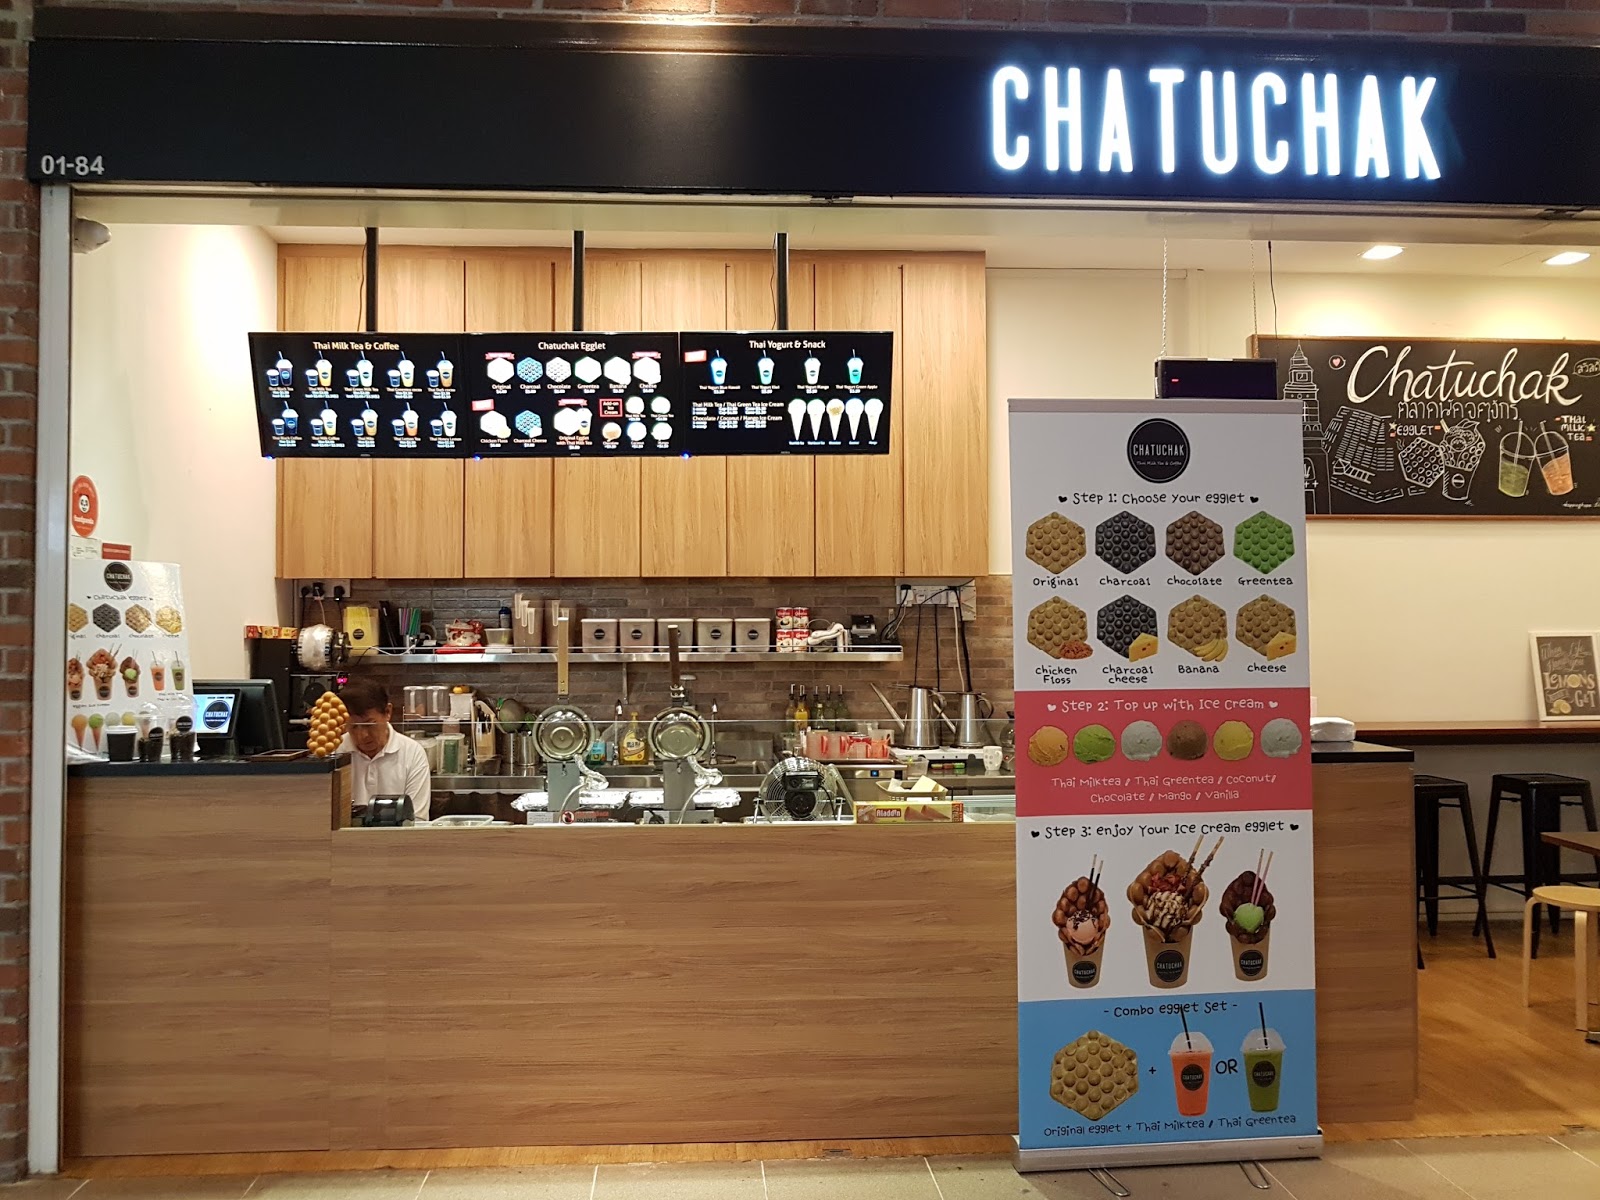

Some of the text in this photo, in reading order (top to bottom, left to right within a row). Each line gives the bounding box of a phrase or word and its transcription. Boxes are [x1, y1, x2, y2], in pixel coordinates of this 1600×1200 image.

[992, 65, 1441, 180] CHATUCHAK
[41, 155, 105, 176] 01-84
[312, 341, 331, 350] Thai
[331, 341, 349, 350] Milk
[349, 341, 364, 350] Tea
[373, 341, 400, 350] Coffee
[538, 341, 606, 352] Chatuchak Egglet
[749, 340, 766, 349] Thai
[767, 340, 793, 351] Yogurt
[802, 340, 826, 349] Snack
[1347, 345, 1583, 406] Chatuchak
[1133, 444, 1184, 456] CHATUCHAK
[1073, 492, 1103, 504] Step
[1108, 493, 1117, 503] 1:
[1122, 493, 1166, 504] Choose
[1033, 576, 1079, 589] Original
[1238, 576, 1293, 586] Greentea
[1178, 665, 1220, 674] Banana
[1043, 675, 1071, 685] Floss
[1062, 700, 1092, 712] Step
[1097, 701, 1109, 711] 2:
[1114, 699, 1139, 711] Top
[1143, 701, 1158, 711] up
[1163, 698, 1194, 711] with
[1199, 699, 1220, 710] Ice
[1051, 777, 1076, 788] Thai
[1079, 777, 1121, 788] Milktea
[1134, 775, 1159, 787] Thai
[1162, 775, 1214, 787] Greentea
[1158, 791, 1192, 801] Mango
[1204, 789, 1239, 800] Vanilla
[1044, 826, 1076, 839] Step
[1080, 826, 1091, 838] 3:
[1175, 823, 1196, 834] Ice
[1114, 1005, 1154, 1018] Combo
[1204, 1000, 1227, 1014] Set
[1215, 1058, 1238, 1075] OR
[1044, 1125, 1085, 1137] Original
[1136, 1121, 1161, 1132] Thai
[1164, 1119, 1205, 1131] Milktea
[1218, 1116, 1242, 1128] Thai
[1246, 1115, 1296, 1127] Greentea
